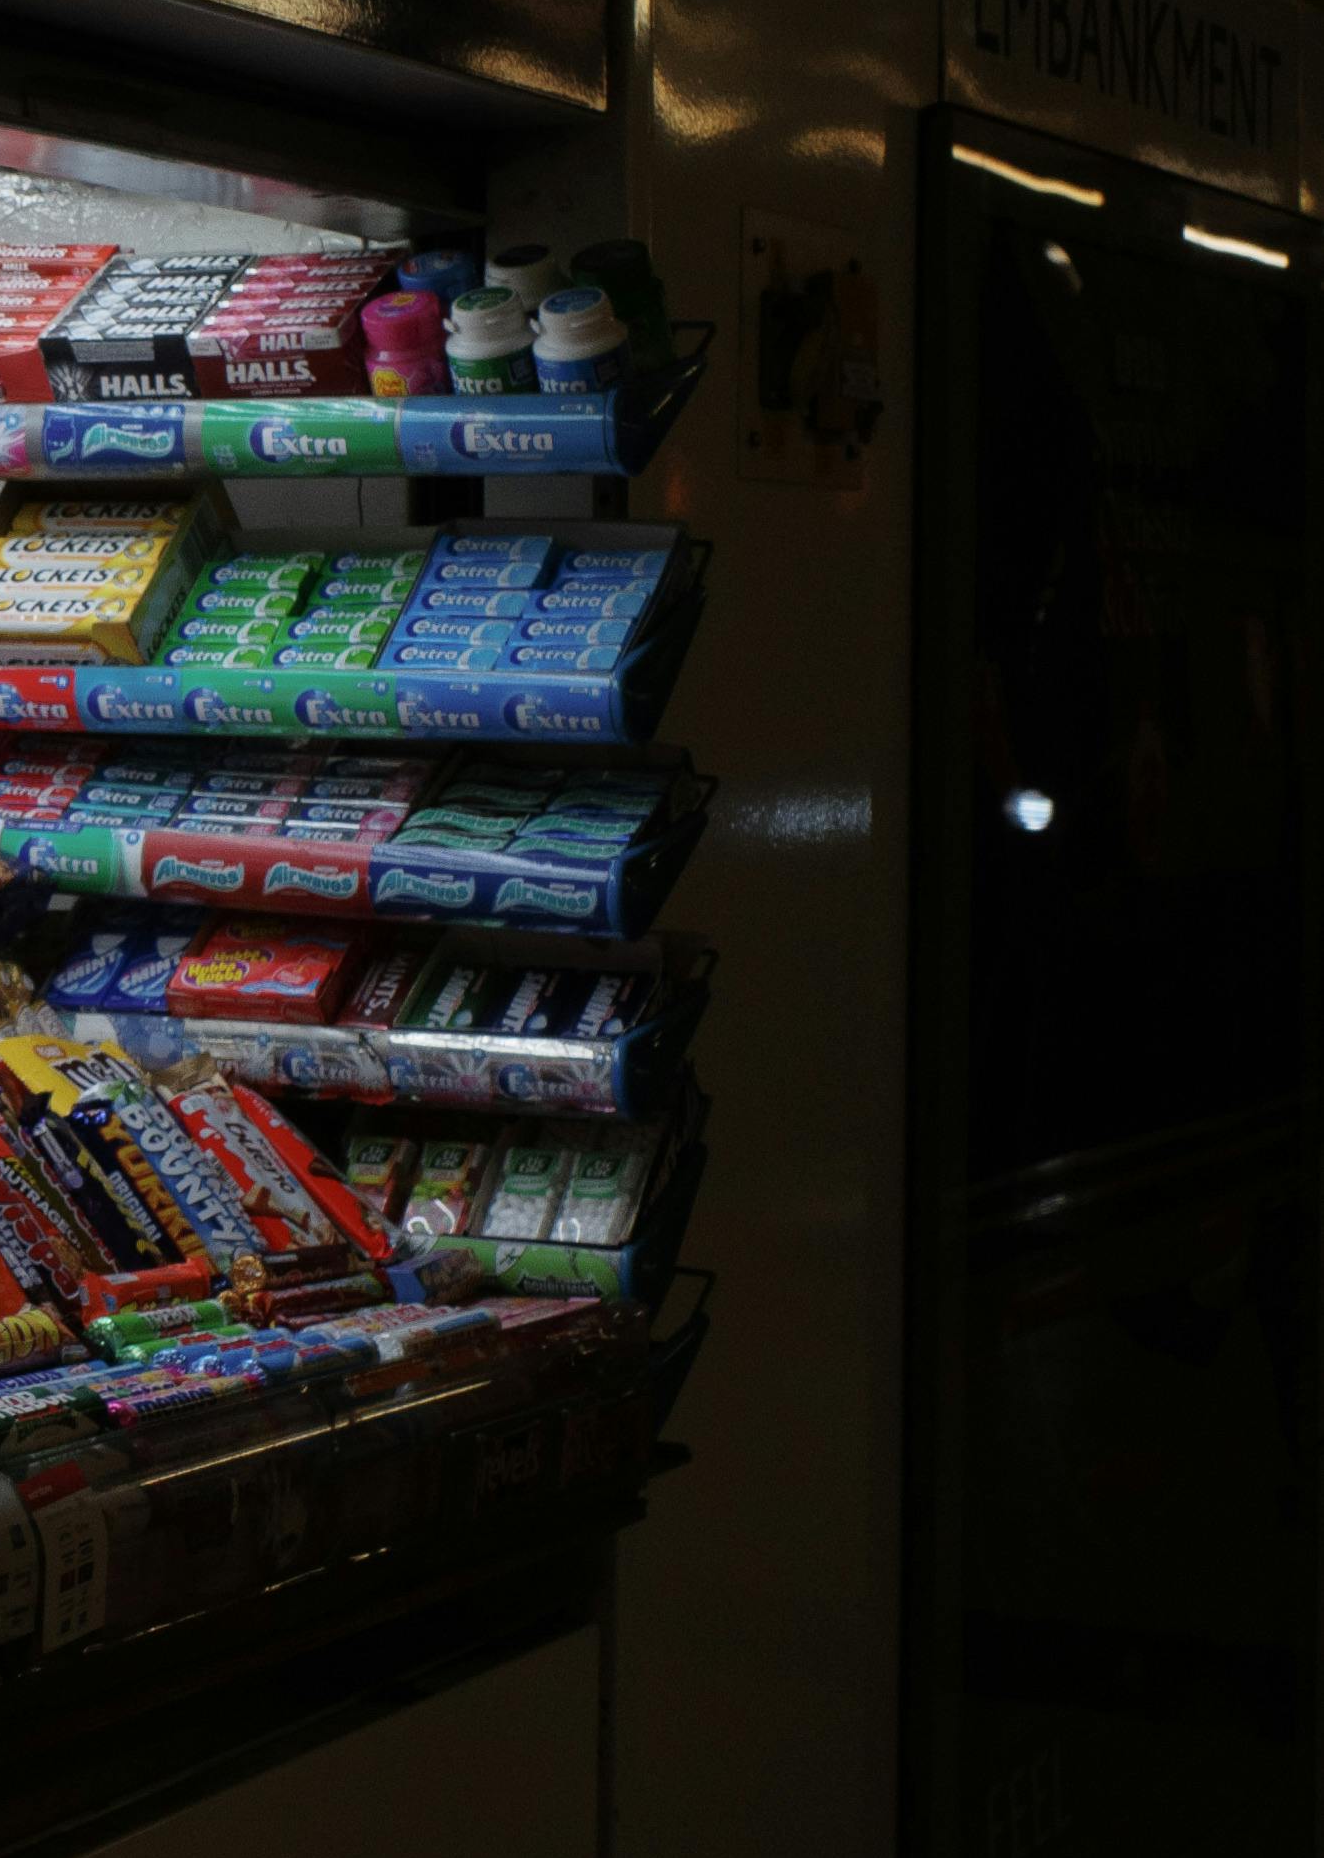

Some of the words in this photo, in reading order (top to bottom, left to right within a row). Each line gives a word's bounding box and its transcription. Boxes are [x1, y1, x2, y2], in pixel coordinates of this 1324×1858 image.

[165, 255, 240, 269] HALLS
[150, 274, 227, 290] HALLS
[121, 305, 198, 321] HALLS
[261, 419, 348, 458] Extra
[464, 419, 553, 455] Extra
[10, 539, 121, 553] LOCKETS
[441, 564, 498, 580] extra
[325, 581, 380, 597] extra
[429, 592, 487, 609] extra
[543, 593, 601, 609] extra
[295, 622, 350, 637] extra
[413, 621, 470, 637] extra
[529, 621, 587, 637] extra
[280, 648, 336, 664] extra
[98, 693, 175, 720] Extra
[194, 693, 273, 725] Extra
[308, 697, 387, 727] Extra
[398, 699, 481, 729] Extra
[517, 701, 601, 732] Extra
[155, 857, 242, 890] Airwaves
[267, 864, 355, 897] Airwaves
[381, 870, 473, 907] Airwaves
[498, 879, 595, 916] Airwaves
[54, 947, 125, 988] SMINT
[187, 962, 236, 980] Hubba
[197, 970, 244, 985] Bubba
[224, 1119, 295, 1195] bueno
[116, 1104, 247, 1241] BOUNTY
